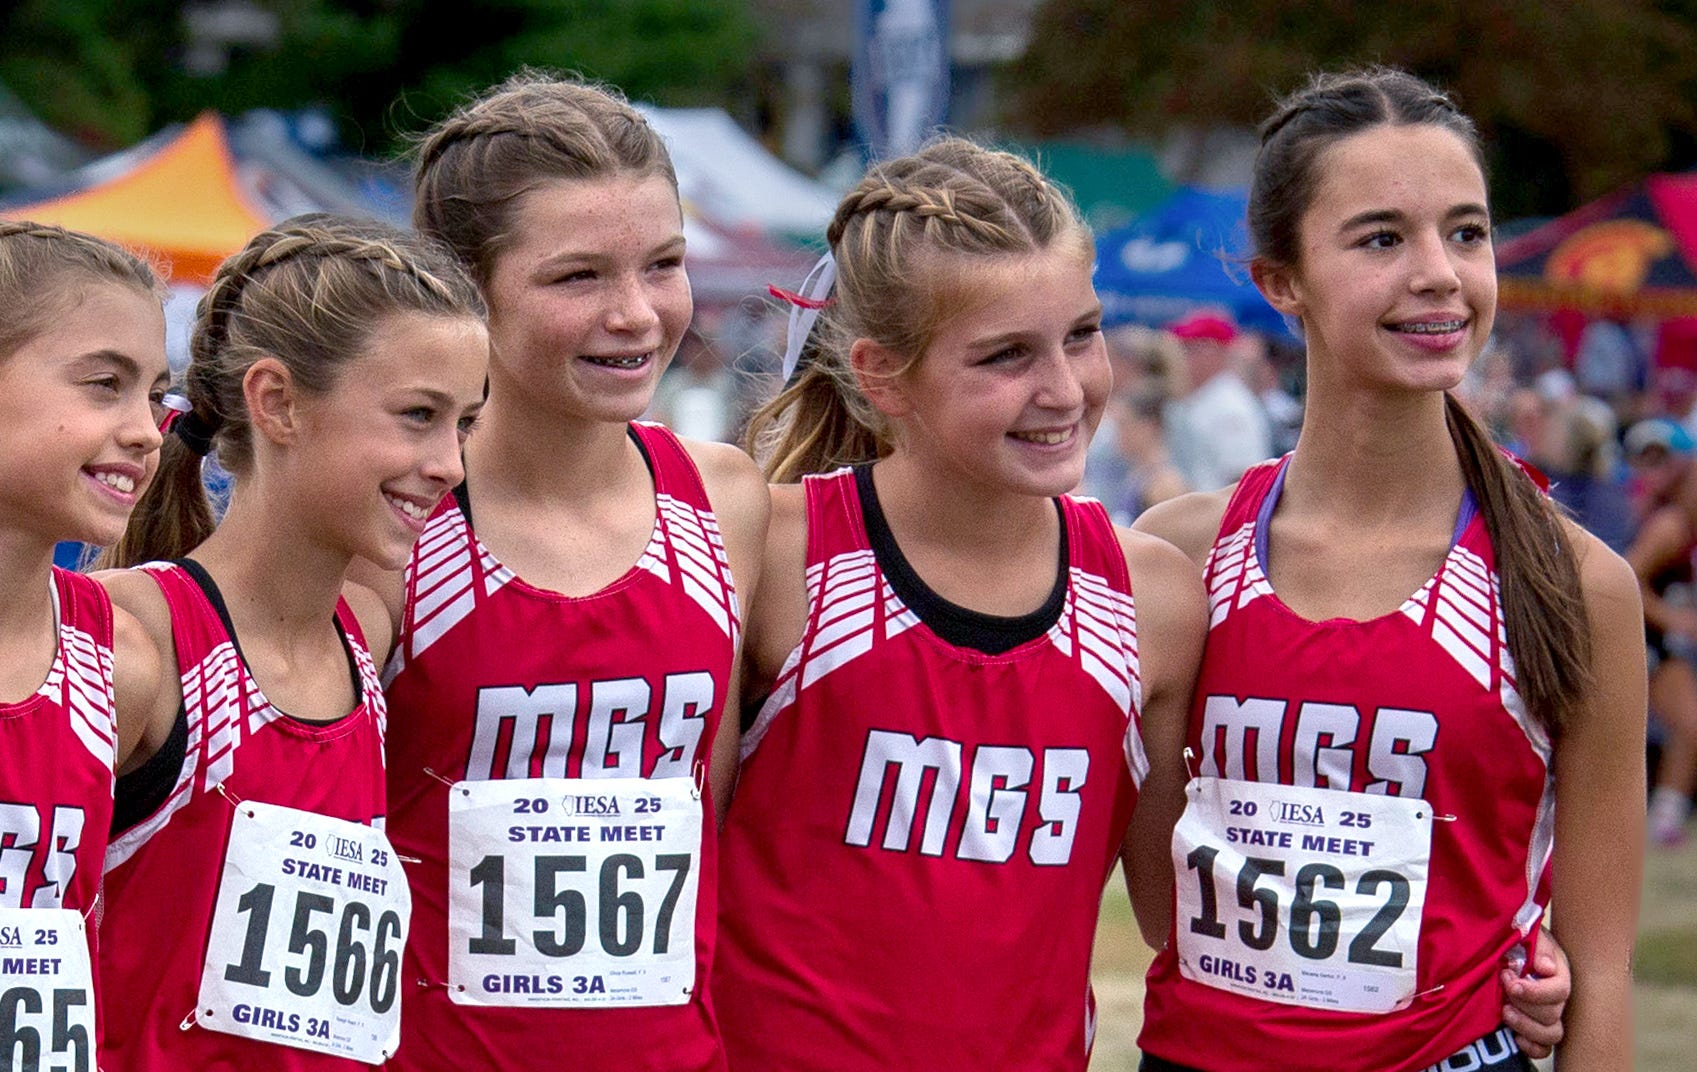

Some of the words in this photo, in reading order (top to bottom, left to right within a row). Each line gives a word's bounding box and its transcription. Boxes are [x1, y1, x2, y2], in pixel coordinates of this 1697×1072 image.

[463, 670, 715, 781] MGS
[1199, 694, 1440, 800] MGS
[513, 798, 549, 813] 20
[575, 795, 620, 814] IESA
[634, 797, 661, 813] 25
[843, 728, 1090, 866] MGS
[1230, 800, 1258, 816] 20
[1281, 802, 1324, 824] IESA
[1339, 811, 1371, 828] 25
[290, 831, 317, 849] 20
[334, 837, 363, 861] IESA
[371, 849, 388, 867] 25
[508, 826, 590, 842] STATE
[600, 825, 665, 842] MEET
[1226, 826, 1293, 848] STATE
[1302, 834, 1374, 856] MEET
[281, 858, 342, 885] STATE
[347, 872, 388, 896] MEET
[469, 853, 691, 957] 1567
[1187, 844, 1411, 968] 1562
[34, 929, 58, 945] 25
[224, 882, 401, 1014] 1566
[2, 958, 61, 974] MEET
[482, 974, 563, 994] GIRLS
[572, 975, 606, 994] 3A
[1199, 954, 1257, 984] GIRLS
[1263, 971, 1295, 992] 3A
[232, 1004, 300, 1033] GIRLS
[306, 1017, 330, 1039] 3A
